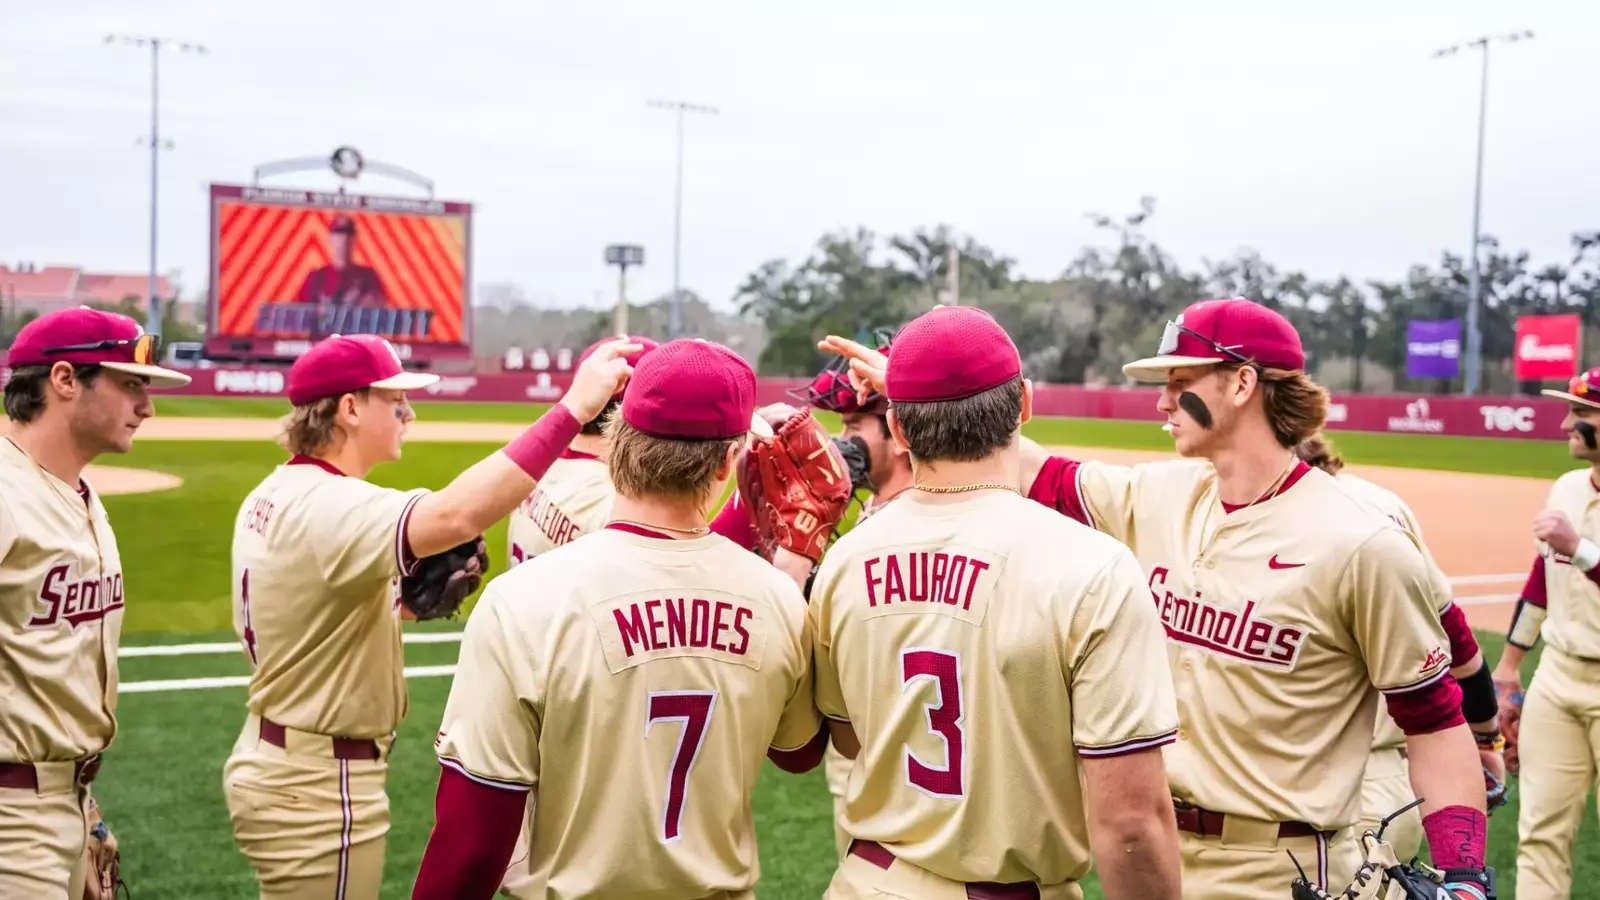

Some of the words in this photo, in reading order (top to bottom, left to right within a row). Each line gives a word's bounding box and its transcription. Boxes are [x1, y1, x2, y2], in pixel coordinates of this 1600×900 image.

[864, 552, 990, 611] FAUROT
[612, 598, 753, 658] MENDES
[901, 647, 966, 800] 3
[645, 689, 719, 844] 7
[1450, 811, 1477, 868] Trus
